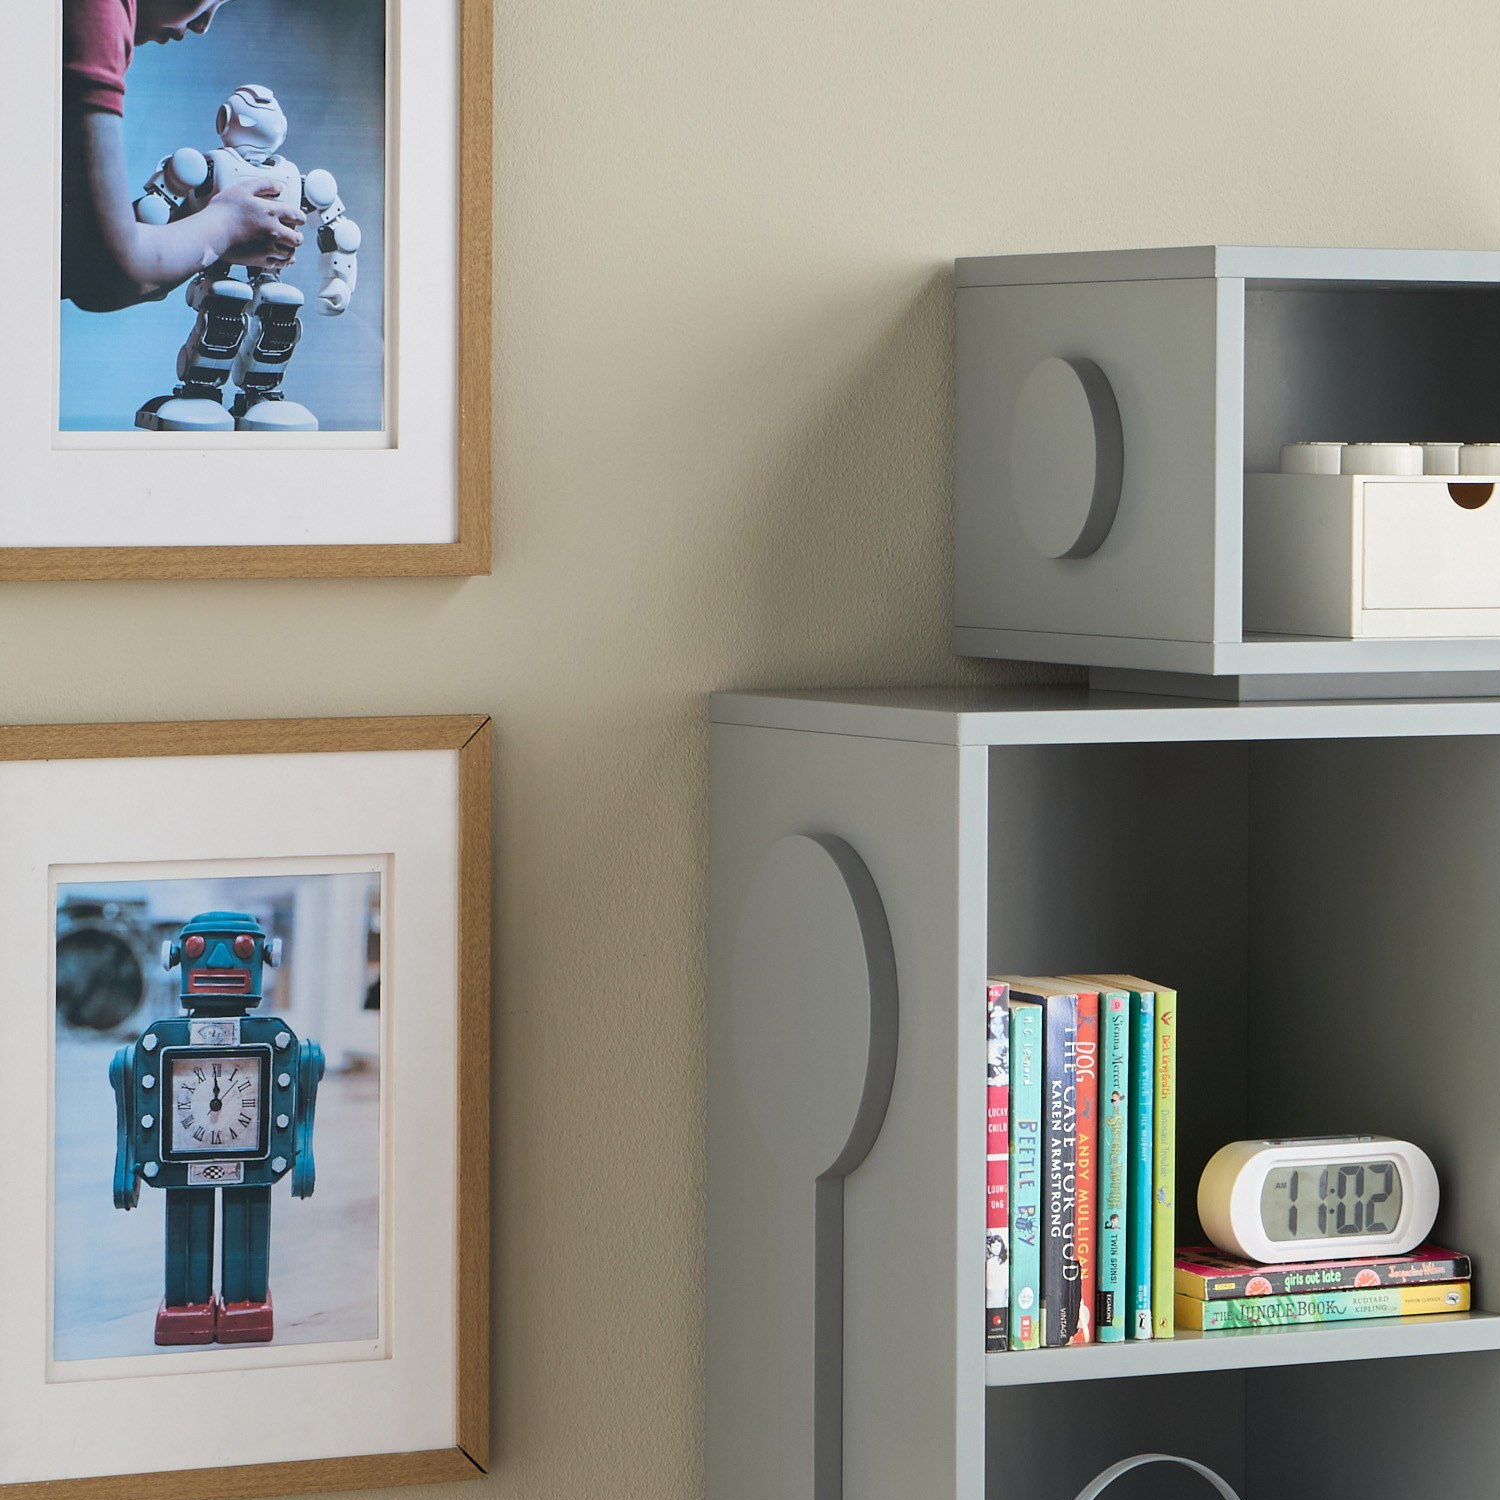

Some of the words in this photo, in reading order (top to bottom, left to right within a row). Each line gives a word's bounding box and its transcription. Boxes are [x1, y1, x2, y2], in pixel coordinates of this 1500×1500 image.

[1111, 1015, 1124, 1050] Sienna
[1161, 1035, 1171, 1052] Dick
[1023, 1045, 1033, 1086] Leonard
[1076, 1042, 1096, 1083] DOG
[1111, 1053, 1124, 1089] Mercer
[988, 1107, 1008, 1117] LUCKY
[1051, 1080, 1062, 1131] KAREN
[1063, 1086, 1077, 1148] CASE
[988, 1123, 1008, 1132] CHILD
[1160, 1109, 1170, 1145] Dinosaur
[1018, 1121, 1038, 1189] BEETLE
[1078, 1133, 1090, 1180] ANDY
[1050, 1138, 1062, 1238] ARMSTRONG
[1062, 1162, 1076, 1213] FOR
[1276, 1182, 1287, 1190] AM
[1288, 1163, 1394, 1237] 11:02
[991, 1200, 1005, 1209] UNG
[1062, 1222, 1079, 1282] GOD
[1077, 1189, 1090, 1280] MULLIGAN
[1110, 1257, 1118, 1284] SPINS!
[1284, 1273, 1305, 1292] girls
[1305, 1273, 1321, 1286] out
[1322, 1270, 1342, 1284] late
[1388, 1265, 1423, 1283] Jacqueline
[1422, 1262, 1446, 1277] Wilson
[1213, 1311, 1234, 1322] THE
[1236, 1301, 1295, 1322] JUNGLE
[1297, 1299, 1346, 1317] BOOK
[1352, 1295, 1389, 1305] RUDYARD
[1354, 1304, 1387, 1313] KIPLING
